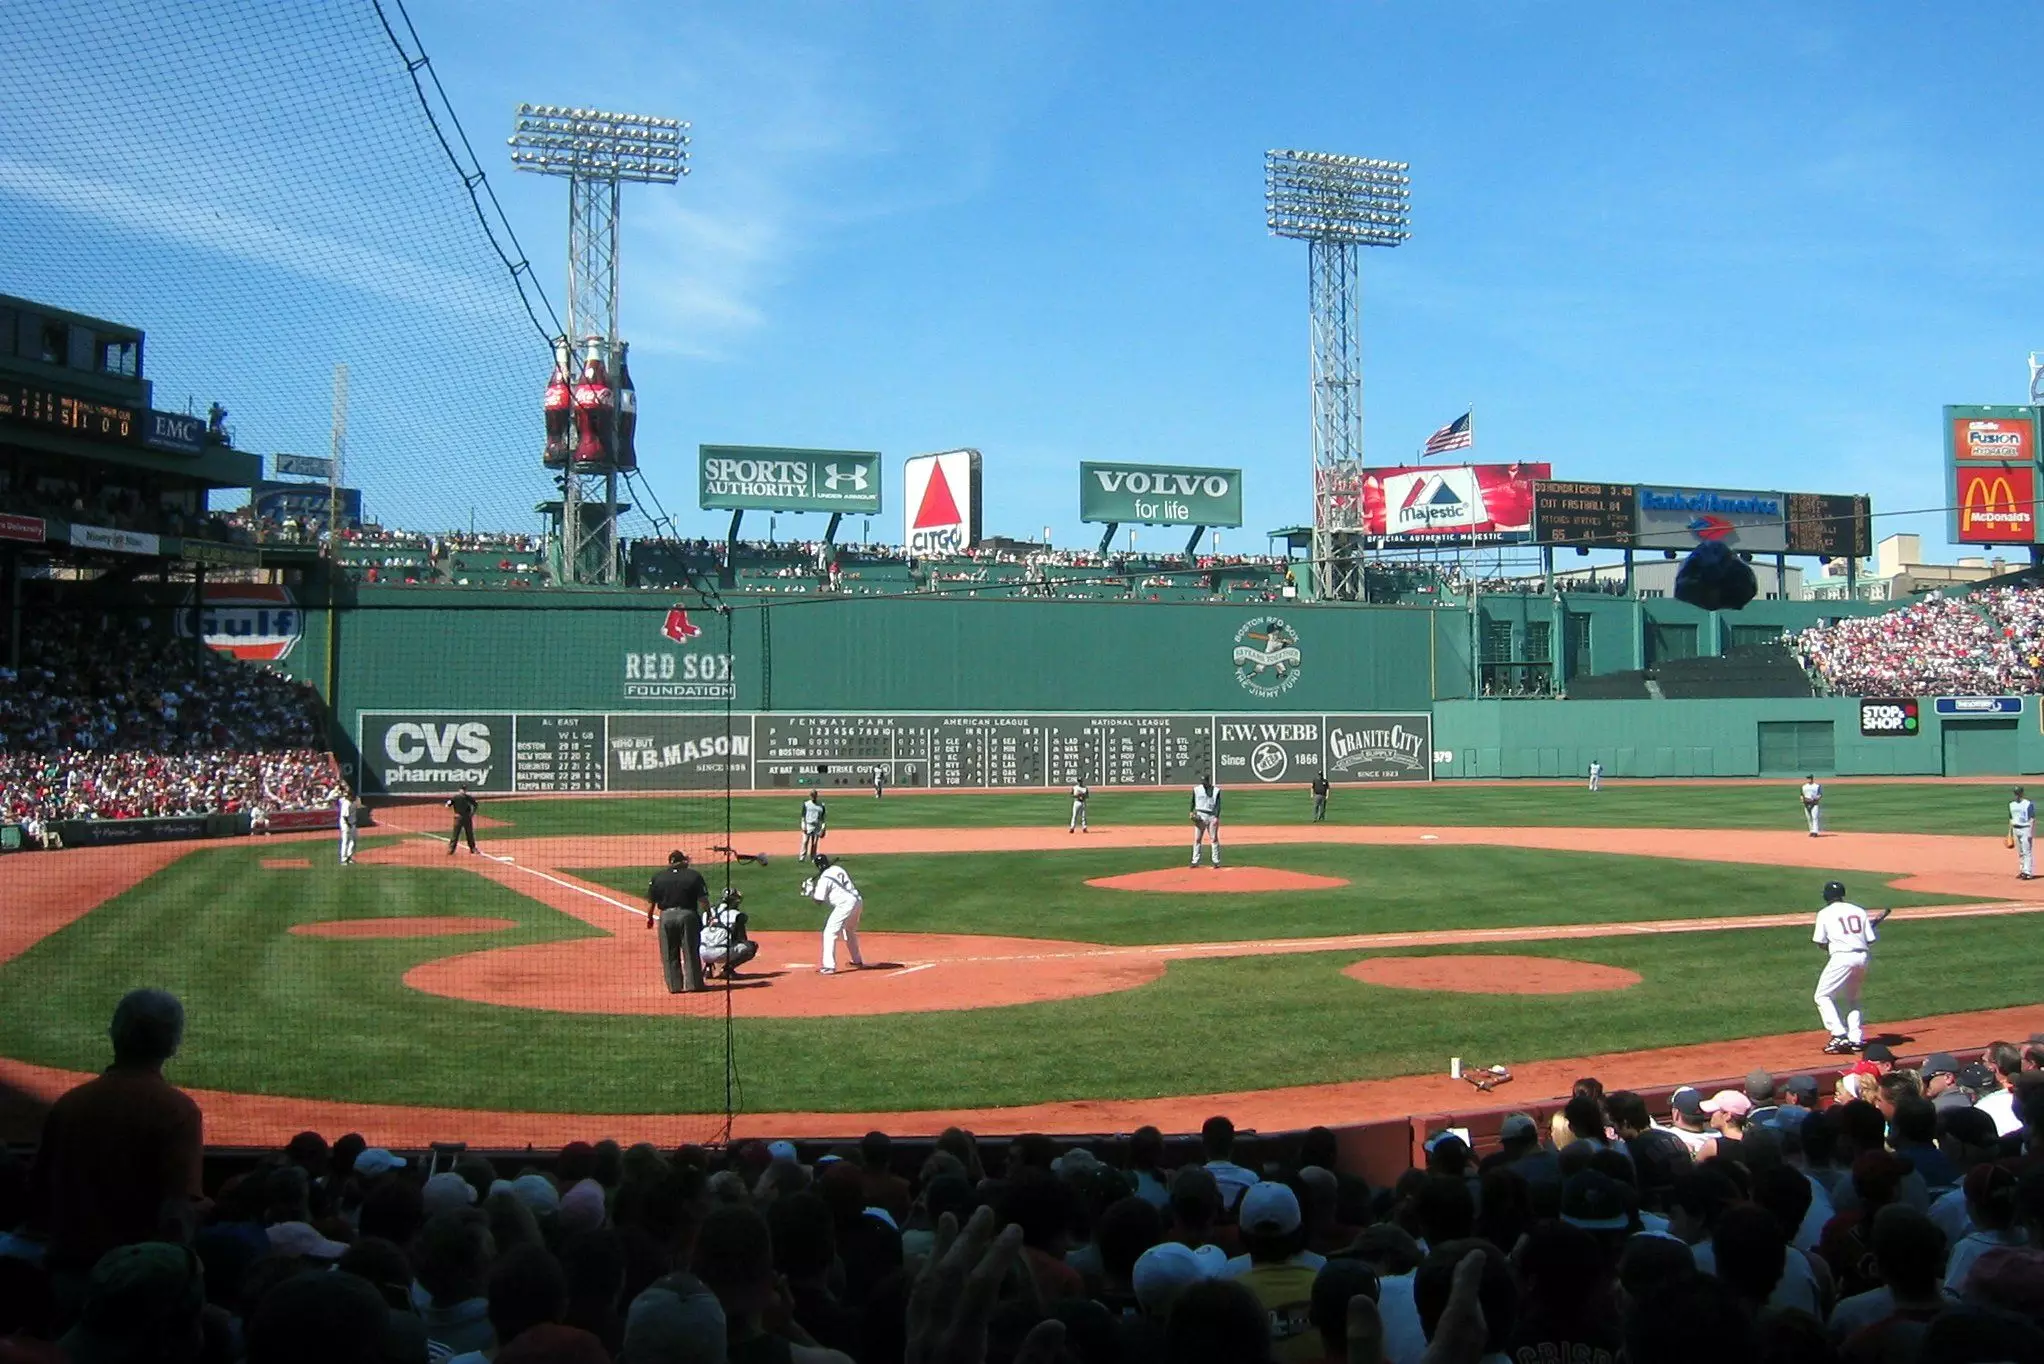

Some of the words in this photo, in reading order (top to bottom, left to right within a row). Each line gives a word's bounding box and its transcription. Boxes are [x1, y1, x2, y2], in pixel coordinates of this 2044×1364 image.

[62, 409, 69, 425] 5
[82, 414, 88, 429] 1
[101, 417, 110, 432] 0
[120, 420, 129, 437] 0
[1970, 431, 2019, 443] Fusion
[704, 458, 808, 485] SPORTS
[1093, 470, 1229, 497] VOLVO
[705, 481, 808, 498] AUTHORITY
[844, 493, 878, 501] ARMOUR
[1640, 489, 1686, 510] Bank
[1708, 491, 1779, 515] America
[1135, 499, 1159, 519] for
[1164, 500, 1189, 520] life
[1970, 512, 2031, 522] McDonald's
[911, 525, 962, 550] CITGO
[1409, 533, 1455, 543] AUTHENTIC
[1234, 616, 1264, 643] BOSTON
[1285, 624, 1300, 643] SOX
[625, 653, 675, 680] RED
[683, 652, 736, 681] SOX
[628, 685, 733, 696] FOUNDATION
[1248, 687, 1279, 698] JIMMY
[541, 718, 552, 726] AL
[557, 718, 580, 726] EAST
[789, 718, 846, 726] FENWAY
[857, 718, 895, 726] PARK
[943, 718, 990, 726] AMERICAN
[994, 718, 1029, 726] LEAGUE
[558, 731, 569, 740] W
[572, 731, 579, 740] L
[809, 727, 814, 736] 1
[816, 727, 822, 736] 2
[824, 727, 830, 736] 3
[833, 727, 840, 736] 4
[841, 727, 847, 736] 5
[848, 727, 855, 736] 6
[858, 727, 864, 736] 7
[990, 727, 997, 735] P
[1259, 723, 1318, 741] WEBB
[385, 721, 492, 765] CVS
[635, 738, 654, 748] BUT
[1064, 737, 1078, 745] LAD
[516, 752, 533, 760] NEW
[584, 752, 591, 760] 2
[778, 748, 806, 757] BOSTON
[816, 748, 823, 757] 0
[1433, 751, 1453, 763] 379
[1064, 760, 1078, 768] FLA
[1220, 754, 1246, 766] Since
[696, 763, 724, 772] SINCE
[768, 766, 778, 774] AT
[779, 766, 793, 774] BAT
[799, 766, 818, 774] BALL
[827, 766, 853, 774] STRIKE
[856, 766, 873, 774] OUT
[384, 764, 490, 786] pharmacy
[1357, 770, 1380, 778] SINCE
[1837, 914, 1862, 935] 10
